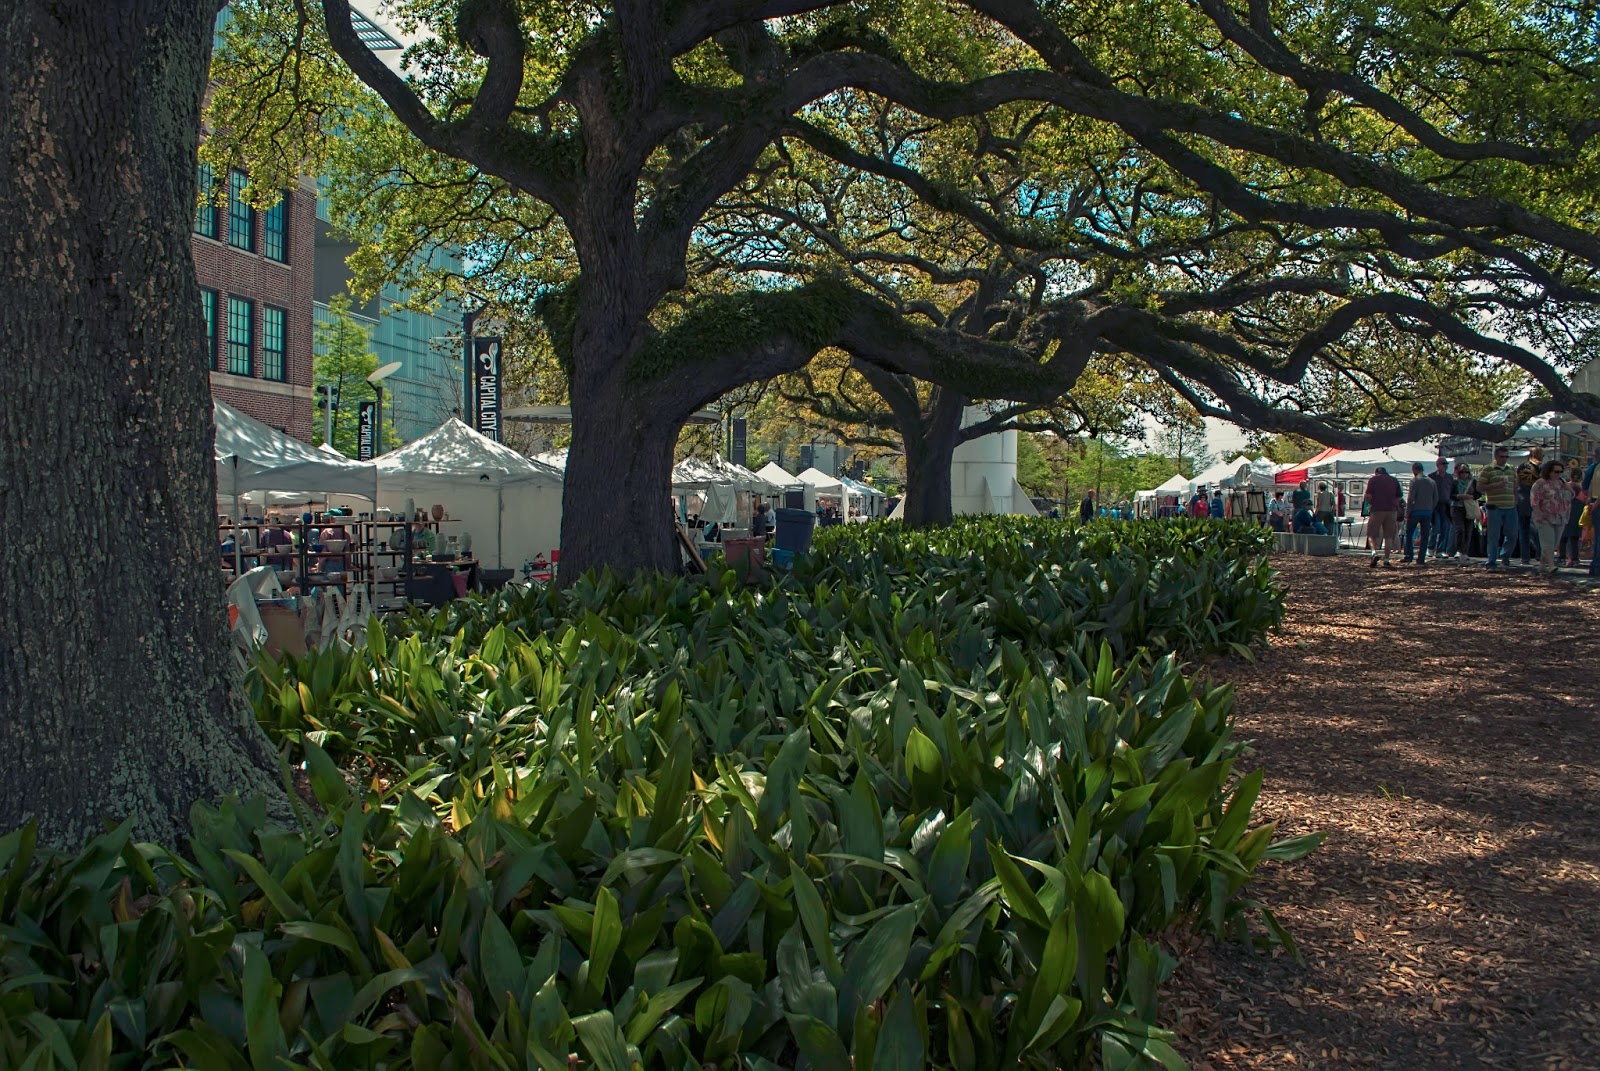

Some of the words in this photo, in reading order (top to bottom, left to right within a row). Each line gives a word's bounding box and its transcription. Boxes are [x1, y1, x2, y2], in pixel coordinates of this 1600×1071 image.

[480, 375, 497, 411] CAPITAL
[481, 411, 497, 430] CITY
[360, 424, 372, 446] CAPITAL
[361, 446, 372, 458] CITY
